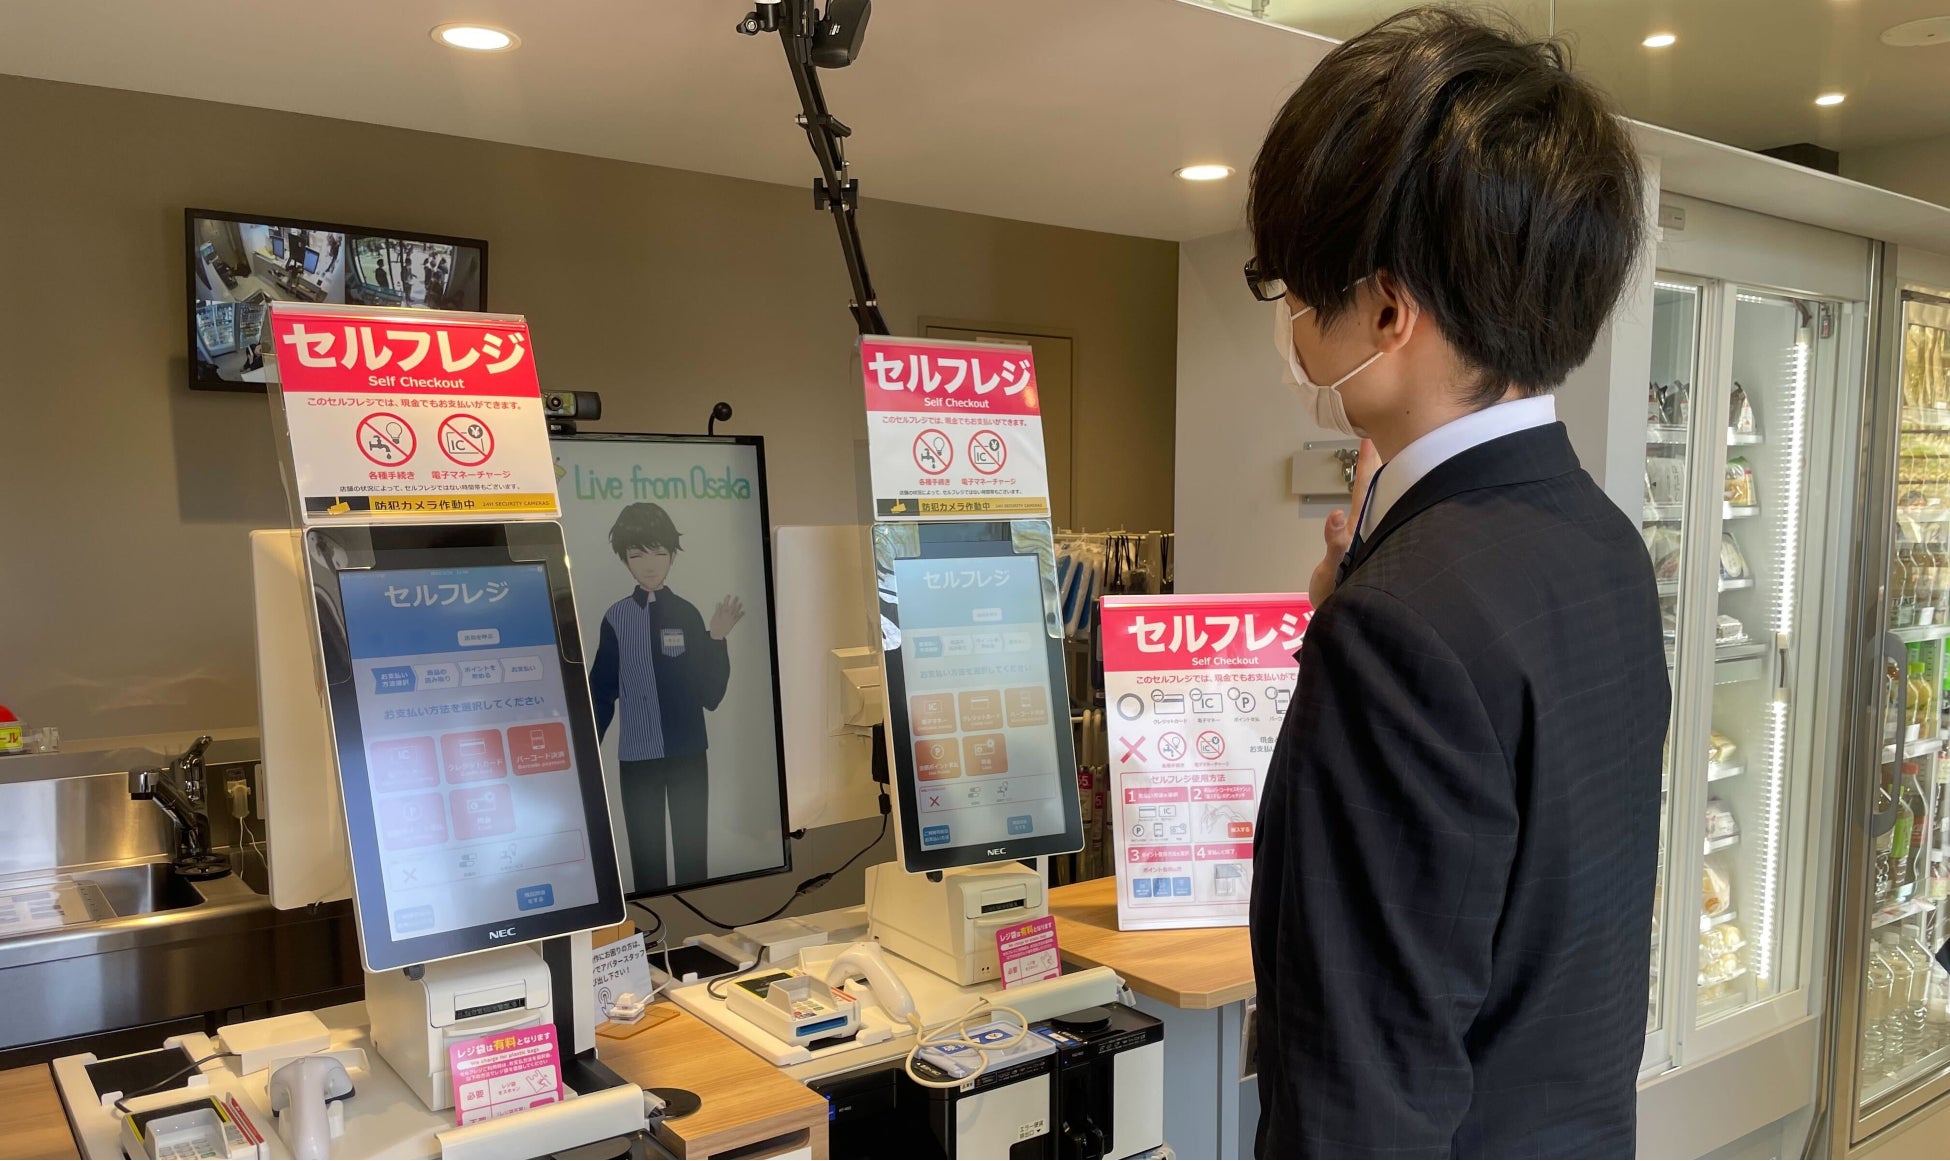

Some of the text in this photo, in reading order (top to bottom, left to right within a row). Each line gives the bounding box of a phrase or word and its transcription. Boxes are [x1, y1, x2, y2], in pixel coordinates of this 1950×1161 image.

[282, 323, 525, 374] セルフレジ
[868, 352, 1031, 396] セルフレジ
[368, 375, 465, 389] Self Checkout
[307, 397, 522, 411] このセルフレジでは、現金でもお支払いができます。
[924, 397, 990, 409] Self Checkout
[369, 471, 415, 480] 各種手続き
[431, 471, 511, 480] 電子マネーチャージ
[574, 464, 751, 500] Live from Osaka
[961, 478, 1016, 486] 電子マネーチャージ
[374, 500, 475, 511] 防犯カメラ作動中
[922, 502, 991, 512] 防犯カメラ作動中
[923, 569, 1010, 590] セルフレジ
[384, 581, 510, 608] セルフレジ
[1128, 613, 1313, 653] セルフレジ
[1191, 656, 1259, 666] Self Checkout
[384, 695, 545, 720] お支払い方法を選択してください
[1128, 791, 1136, 802] 1
[1193, 788, 1202, 800] 2
[987, 848, 1007, 856] NEC
[1130, 850, 1140, 861] 3
[1197, 847, 1206, 858] 4
[489, 927, 516, 940] NEC
[457, 1032, 551, 1058] レジ袋は有料となります
